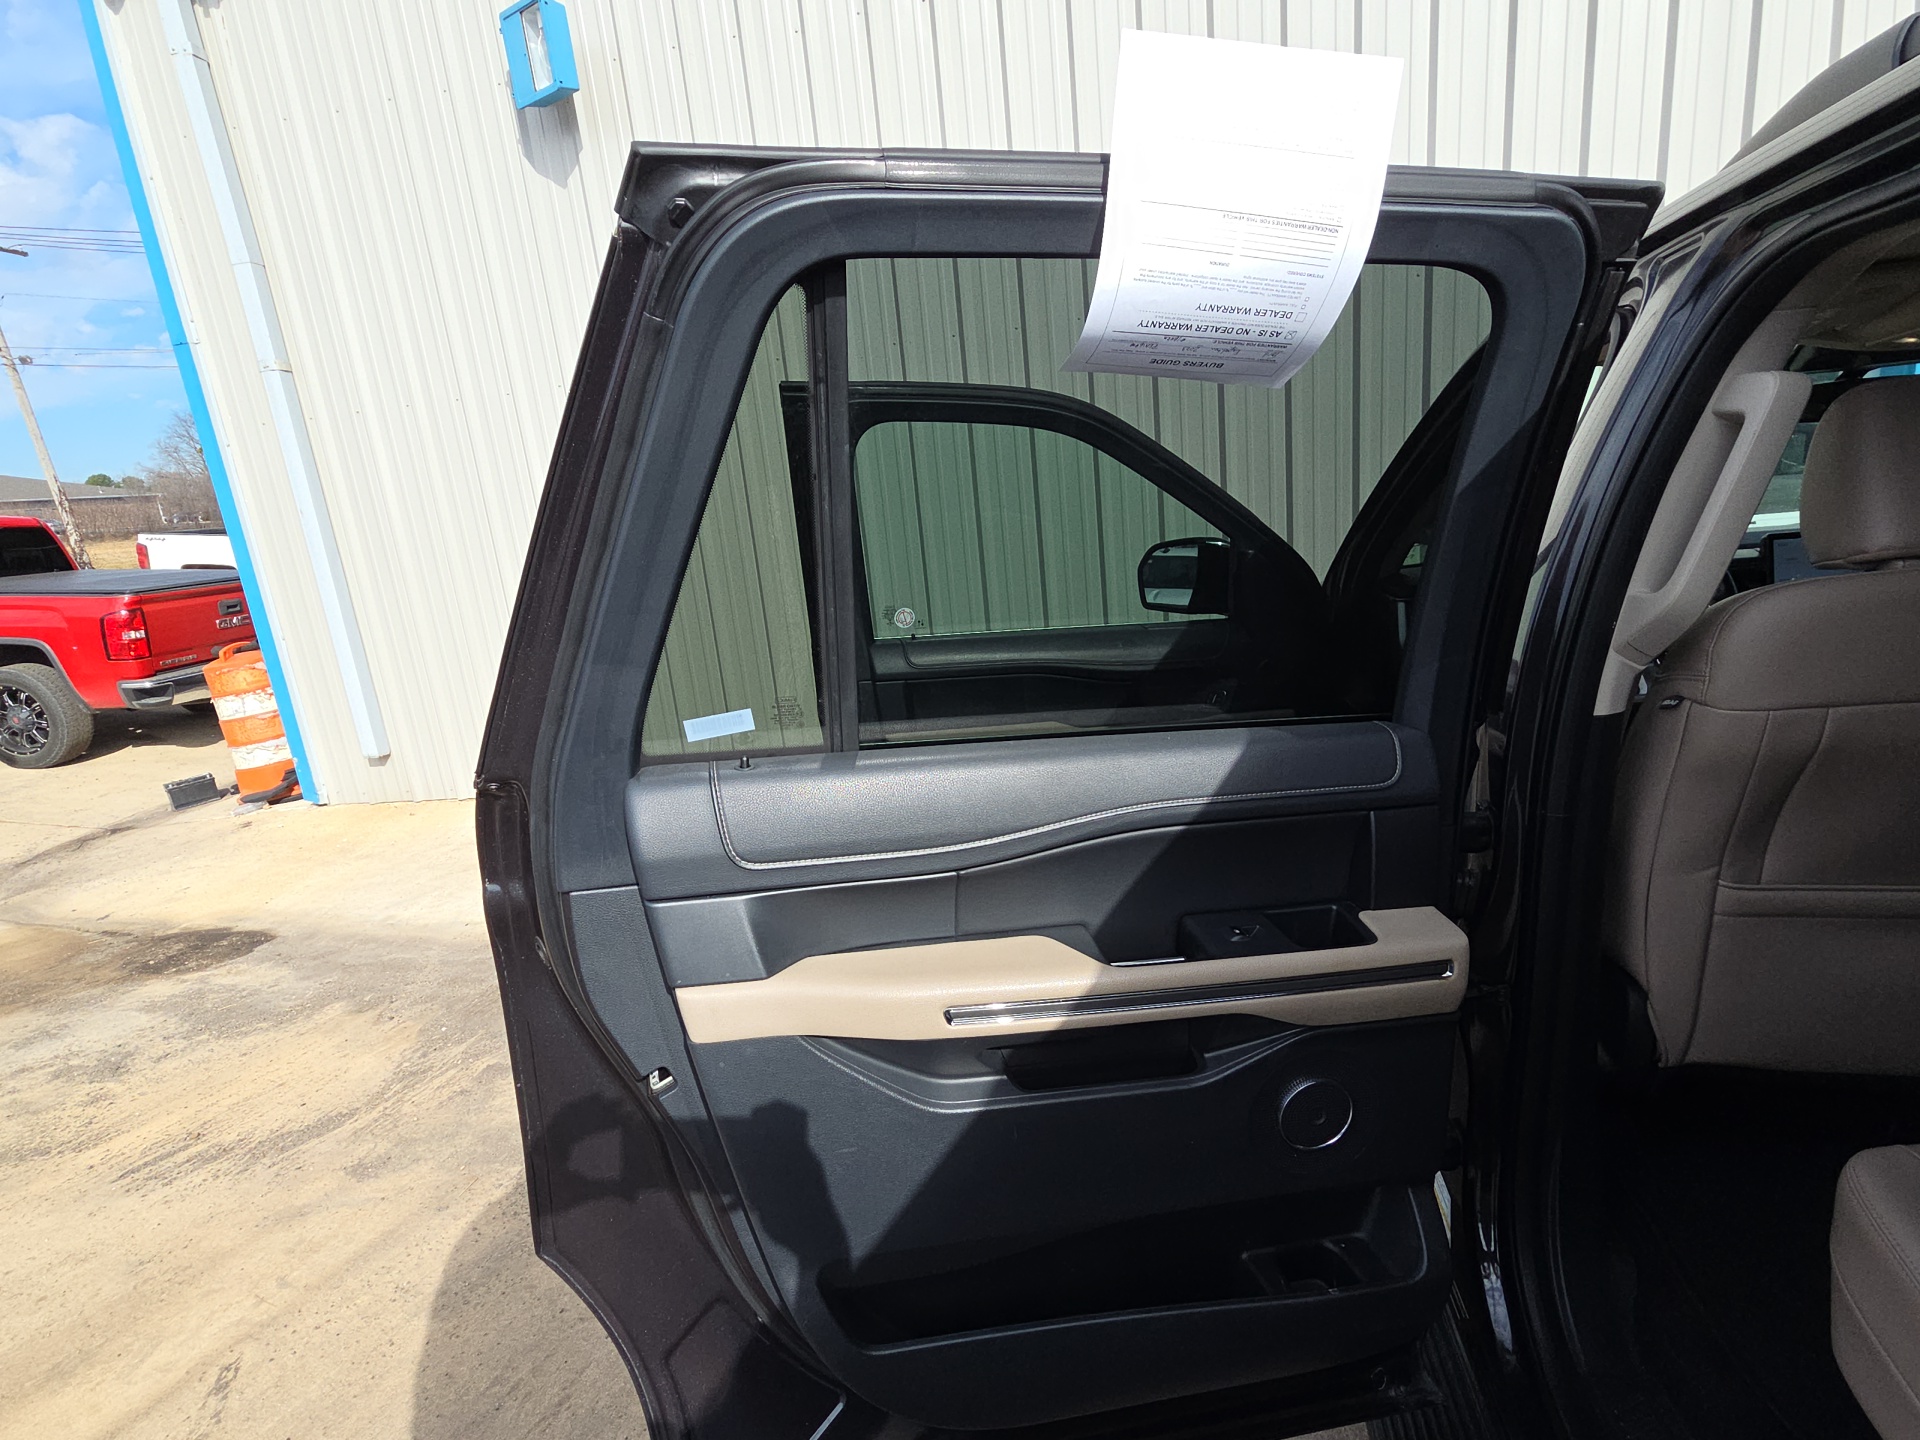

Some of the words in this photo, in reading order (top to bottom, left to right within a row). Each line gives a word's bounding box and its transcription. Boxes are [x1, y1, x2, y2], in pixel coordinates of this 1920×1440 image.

[1271, 220, 1307, 230] WARRANTIES
[1195, 302, 1252, 315] WARRANTY
[1254, 308, 1293, 319] DEALER
[1137, 319, 1193, 331] WARRANTY
[1195, 324, 1234, 334] DEALER
[1236, 327, 1251, 336] NO
[1258, 329, 1268, 337] IS
[1268, 330, 1283, 338] AS
[1149, 358, 1181, 366] GUIDE
[1183, 360, 1224, 369] BUYERS
[216, 614, 250, 629] GMC
